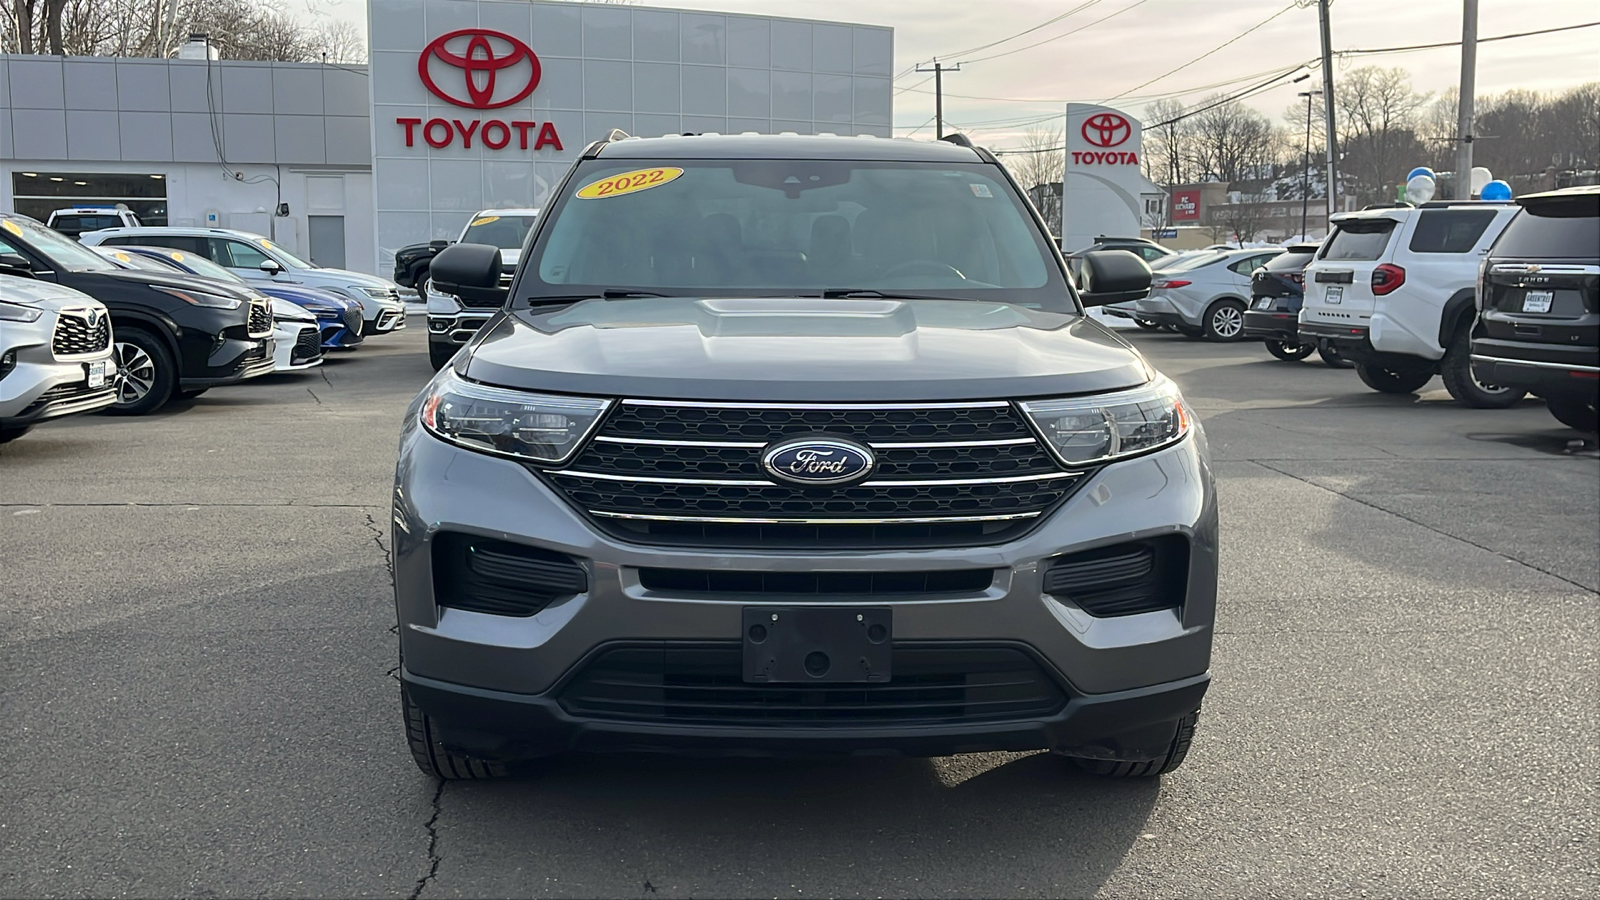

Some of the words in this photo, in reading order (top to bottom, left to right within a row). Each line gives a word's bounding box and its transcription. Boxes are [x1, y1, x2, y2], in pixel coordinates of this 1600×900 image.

[396, 118, 564, 150] TOYOTA
[1072, 152, 1138, 165] TOYOTA
[597, 169, 665, 196] 2022
[790, 449, 848, 474] Ford
